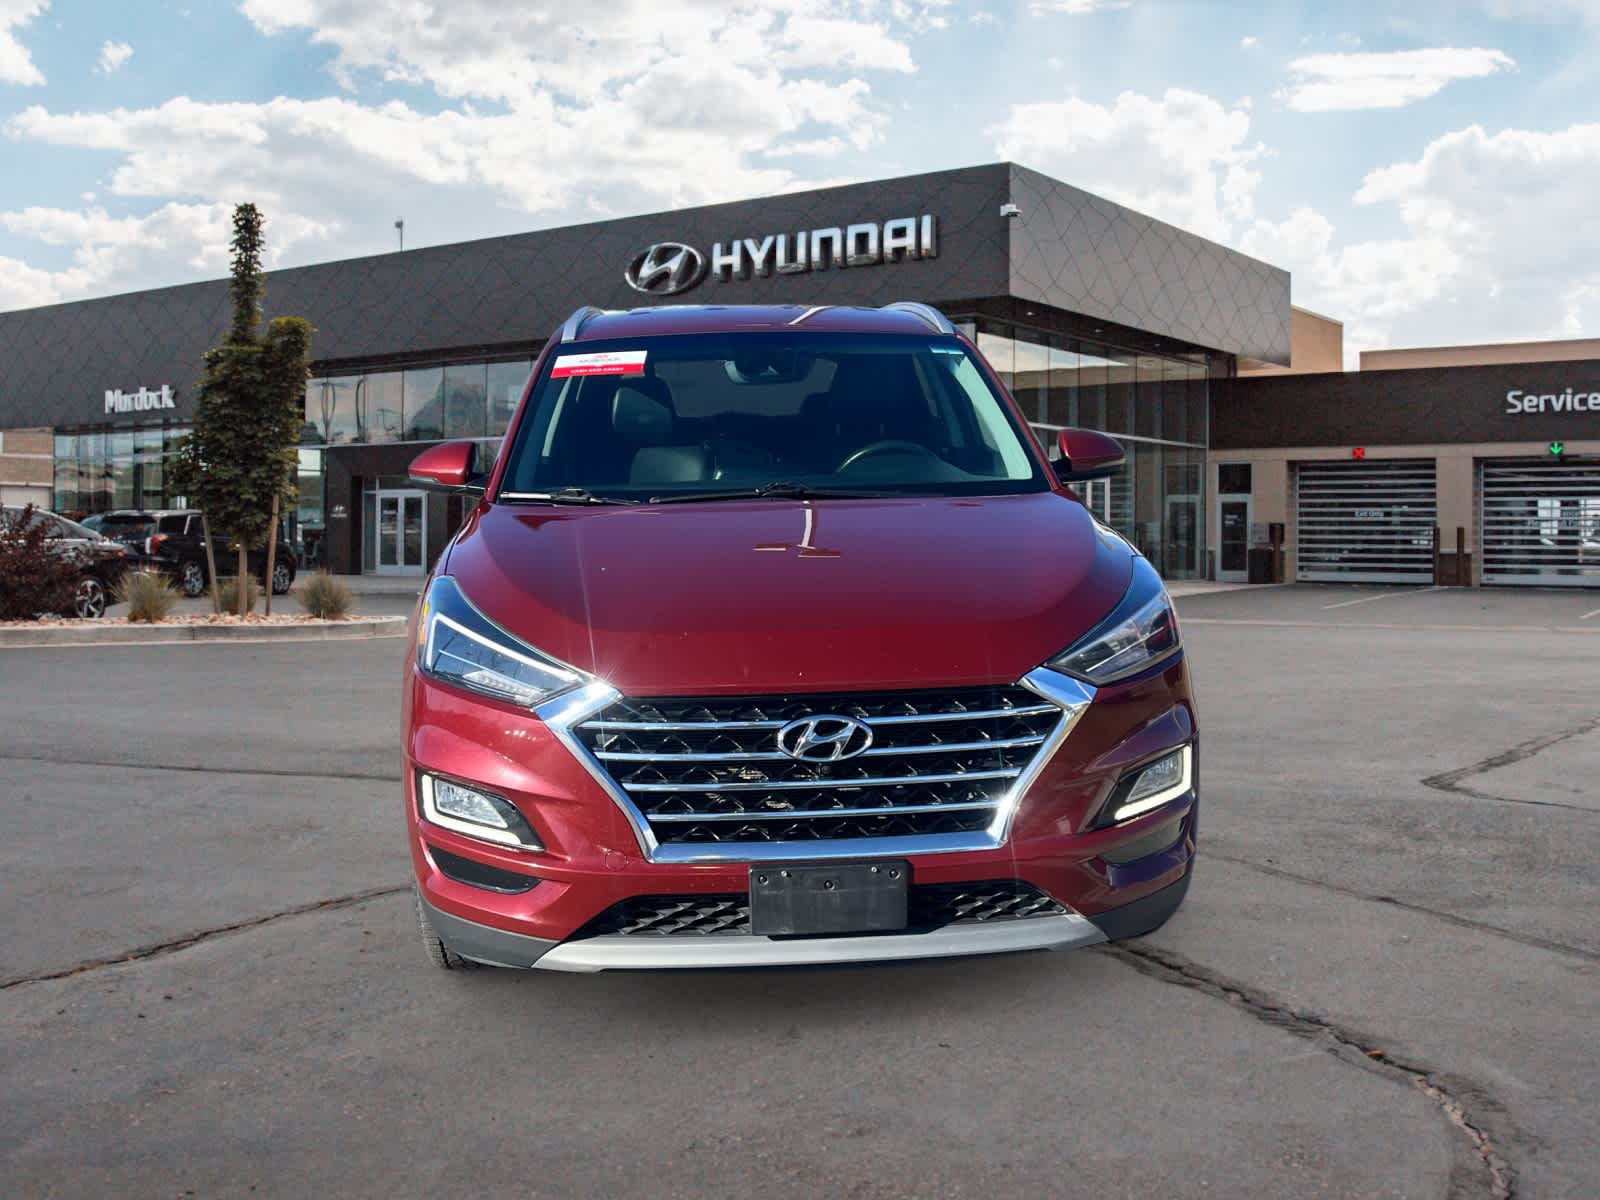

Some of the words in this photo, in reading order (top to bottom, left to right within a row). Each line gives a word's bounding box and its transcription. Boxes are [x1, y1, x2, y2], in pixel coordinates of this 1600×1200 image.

[711, 214, 938, 282] HYUNDAI
[104, 384, 175, 413] Murdock
[1505, 388, 1600, 414] Service
